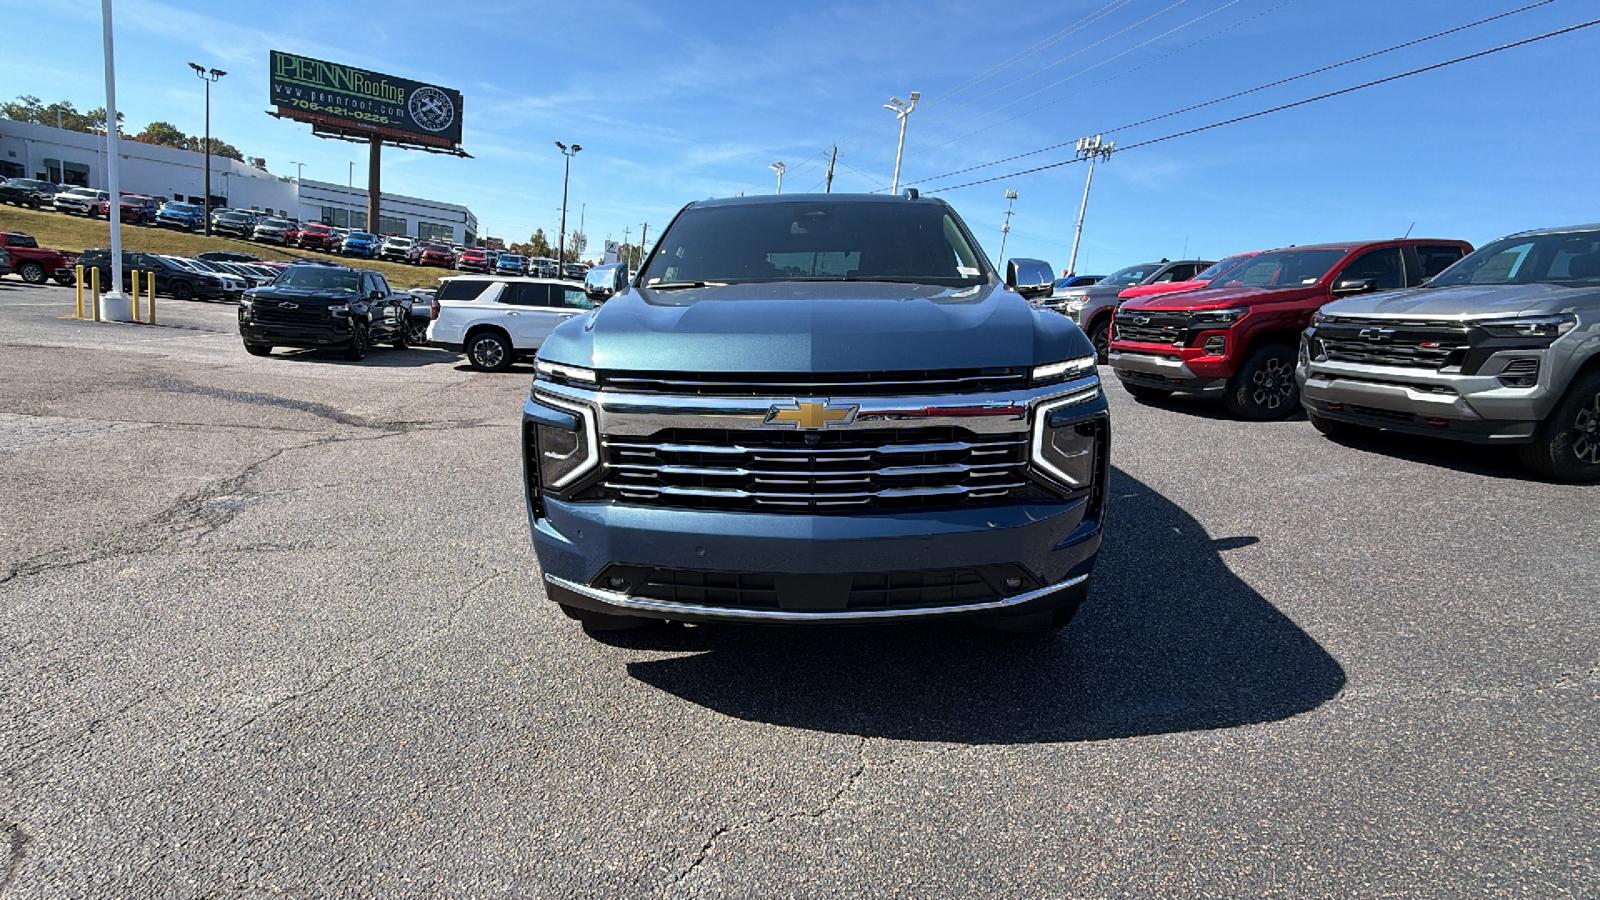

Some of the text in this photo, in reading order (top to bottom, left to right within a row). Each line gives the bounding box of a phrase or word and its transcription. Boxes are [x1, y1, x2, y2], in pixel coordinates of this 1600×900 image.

[275, 53, 404, 105] PENN Roofing
[275, 84, 404, 118] www.pennroof.com
[290, 98, 389, 124] 706-421-0226
